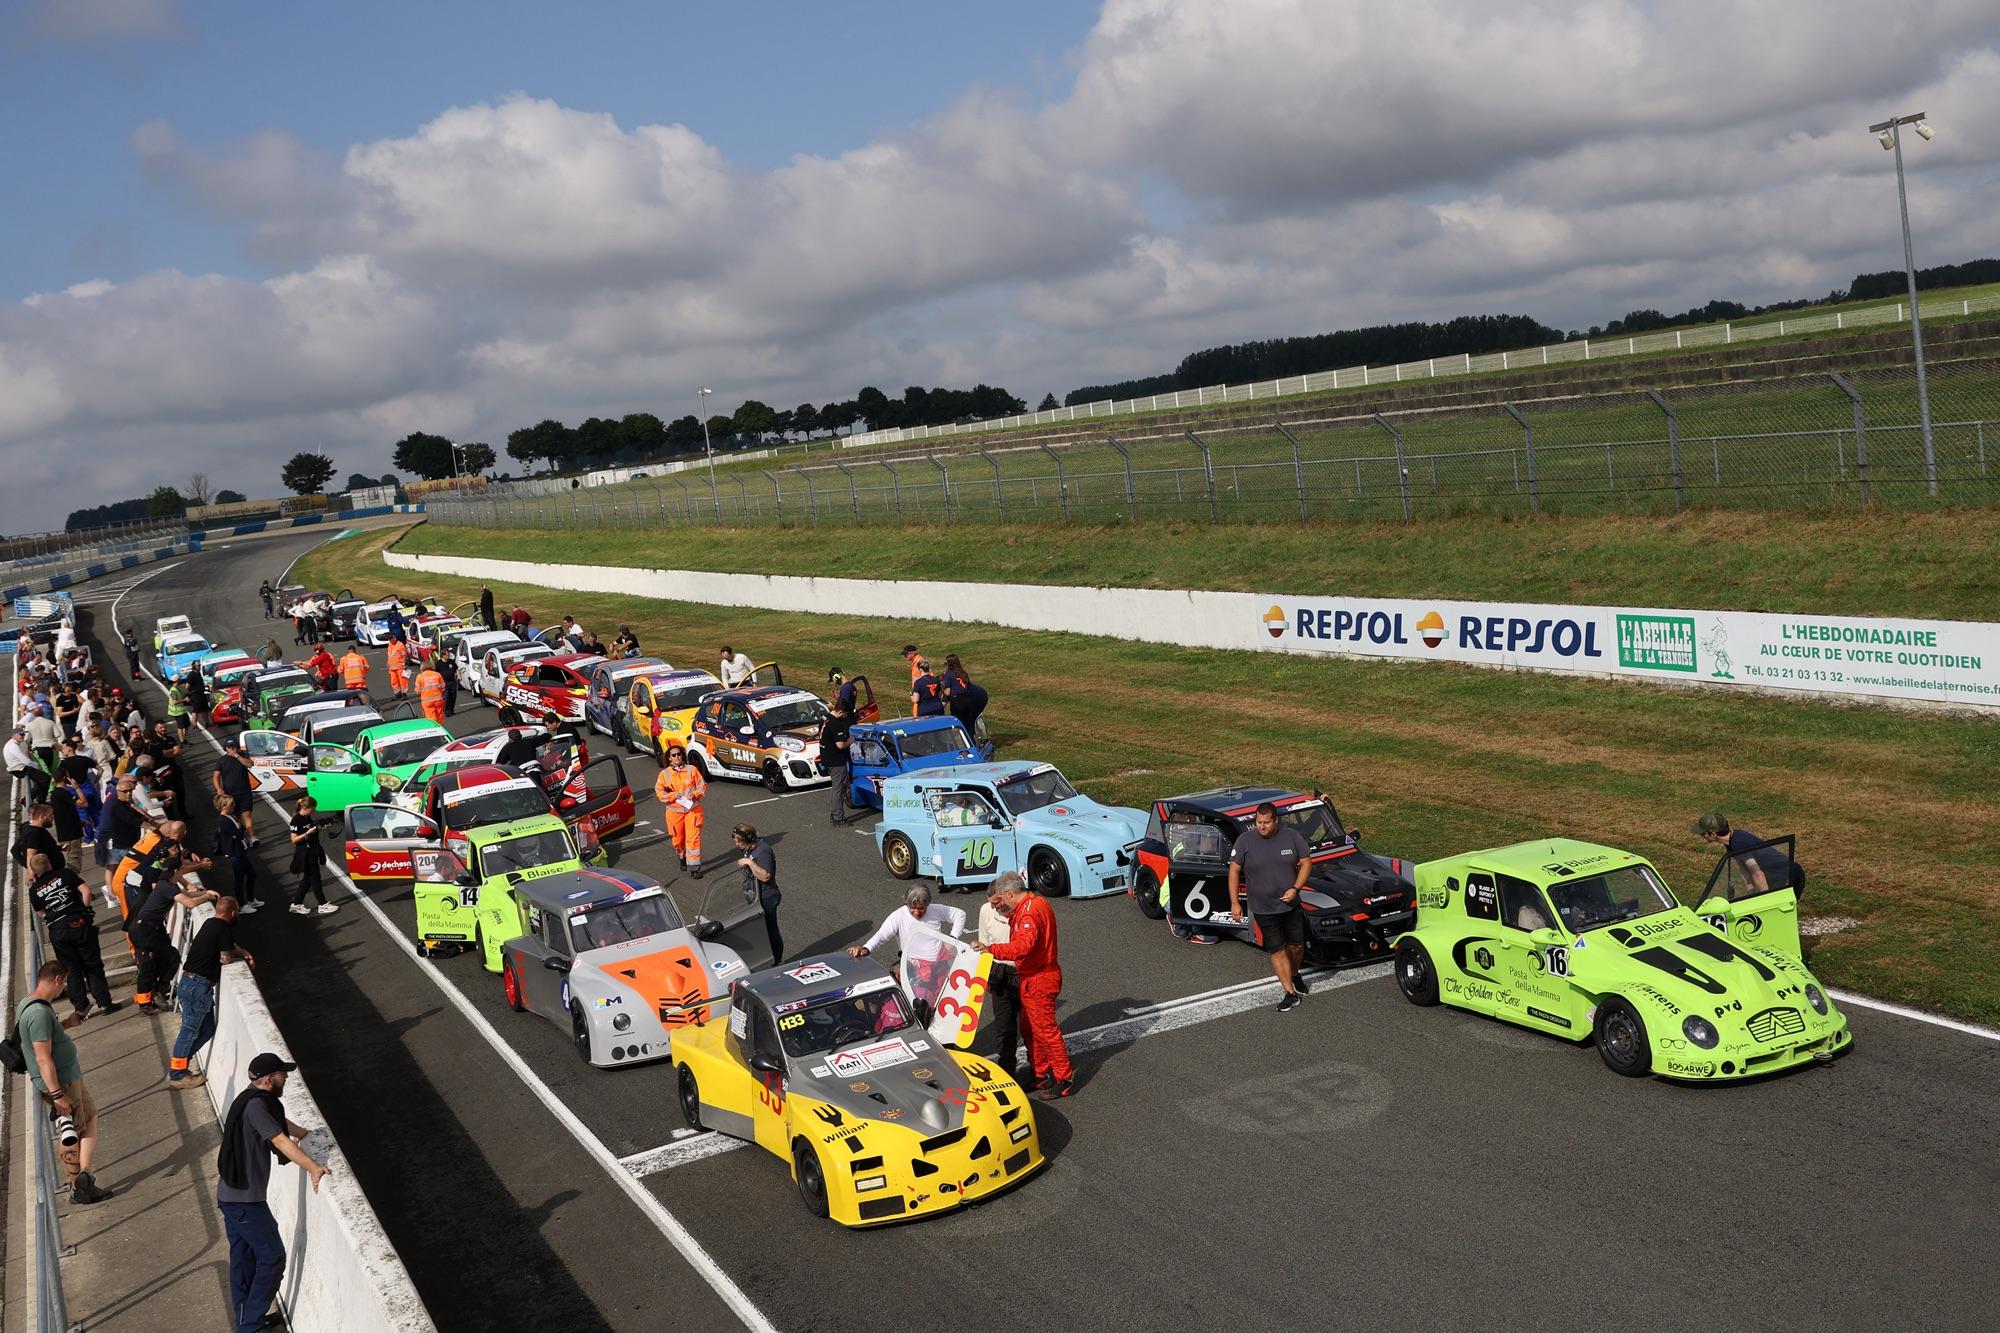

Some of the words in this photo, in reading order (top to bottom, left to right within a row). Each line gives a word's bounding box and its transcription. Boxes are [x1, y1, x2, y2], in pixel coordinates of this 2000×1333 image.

[1297, 609, 1408, 644] REPSOL
[1782, 624, 1937, 647] L'HEBDOMADAIRE
[1459, 616, 1602, 657] REPSOL
[1621, 620, 1692, 653] L'ABEILLE
[1634, 650, 1643, 662] DE
[1647, 651, 1656, 664] LA
[1658, 651, 1693, 666] TERNOISE
[1760, 644, 1778, 656] AU
[1824, 647, 1842, 660] DE
[1846, 649, 1894, 664] VOTRE
[1897, 652, 1982, 669] QUOTIDIEN
[1745, 665, 1764, 676] Tél.
[1767, 666, 1779, 678] 03
[1782, 668, 1794, 679] 21
[1797, 669, 1811, 680] 03
[1813, 670, 1827, 682] 13
[1829, 672, 1844, 683] 32
[506, 695, 556, 713] SUSPENSION
[477, 785, 514, 796] Citropol
[960, 837, 994, 870] 10
[1564, 854, 1608, 868] Blaise
[381, 860, 413, 869] dechesn
[527, 865, 564, 879] Blaise
[37, 878, 62, 898] STAFF
[461, 888, 478, 905] 14
[1184, 880, 1210, 919] 6
[422, 912, 440, 920] Pasta
[1634, 918, 1684, 937] Blaise
[1548, 947, 1567, 975] 16
[1509, 966, 1528, 980] Pasta
[1444, 977, 1462, 994] The
[1463, 983, 1493, 1001] Golden
[1495, 989, 1521, 1008] Horse
[1515, 980, 1532, 993] della
[1532, 985, 1561, 1002] Mamma
[938, 969, 988, 1032] 33
[1714, 1000, 1742, 1018] pvd
[779, 1014, 806, 1031] H33
[838, 1060, 861, 1071] BATI
[1667, 1061, 1709, 1074] BODARWE
[971, 1081, 1017, 1093] William
[823, 1122, 869, 1144] William
